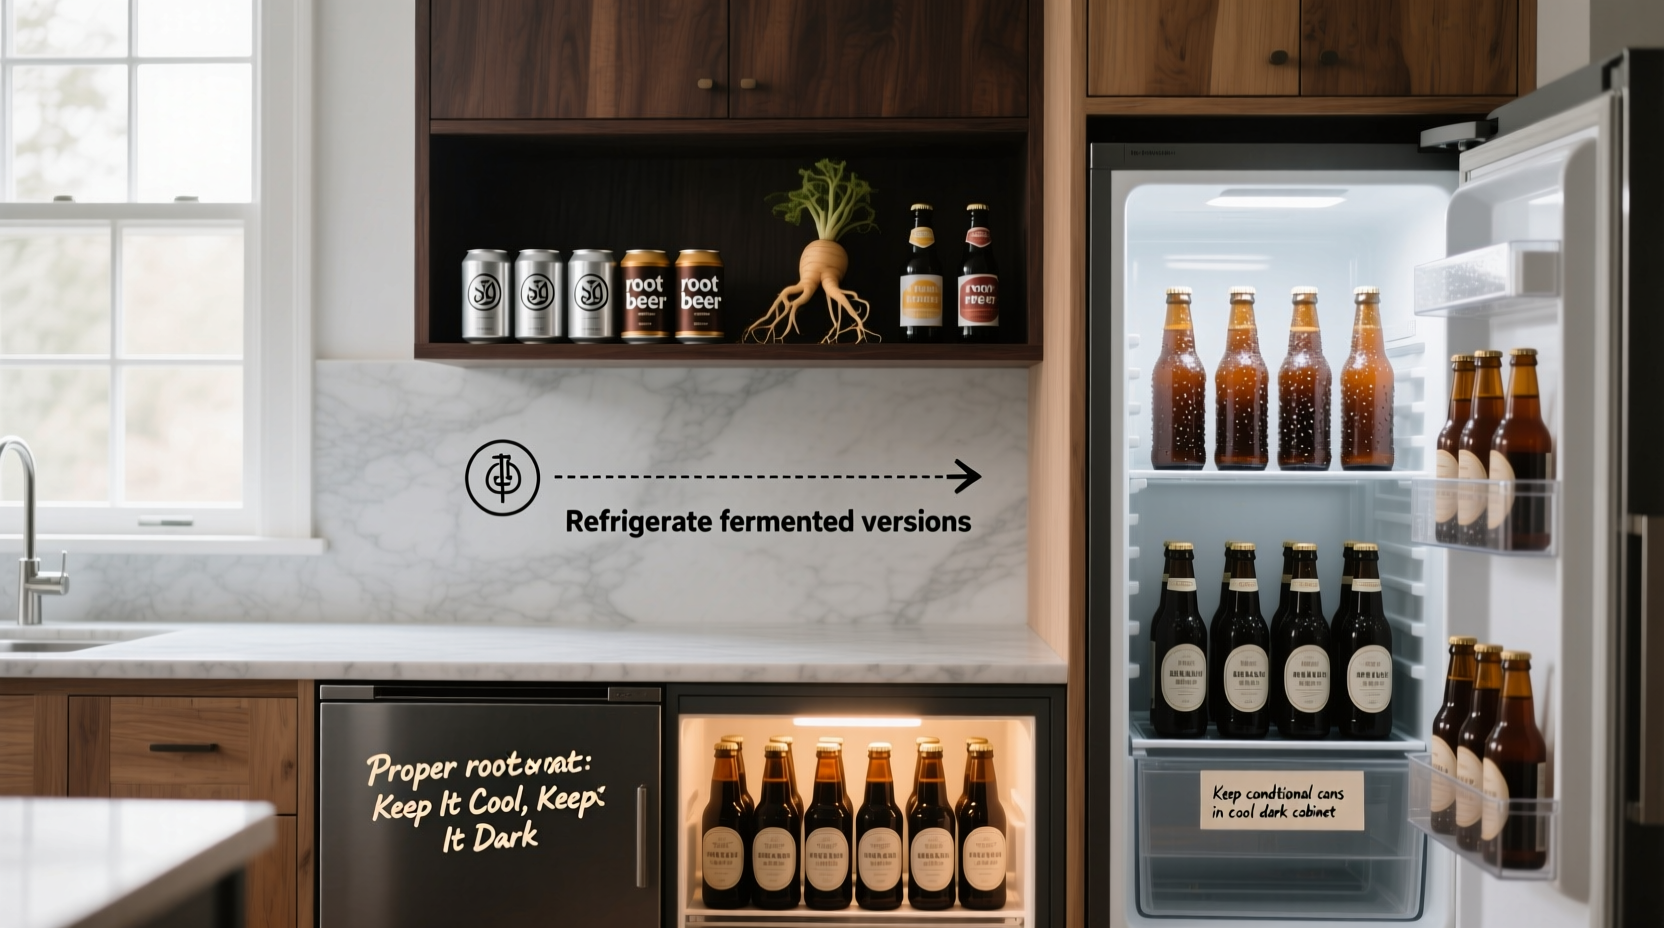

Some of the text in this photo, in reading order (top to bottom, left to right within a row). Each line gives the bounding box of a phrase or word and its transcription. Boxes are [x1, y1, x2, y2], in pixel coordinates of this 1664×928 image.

[626, 275, 664, 292] root
[681, 275, 719, 292] root
[626, 293, 667, 310] beer
[681, 293, 722, 310] beer
[565, 508, 972, 539] Refrigerate fermented versions
[366, 753, 457, 792] Proper
[1213, 783, 1345, 805] Keep condtional cans
[372, 793, 432, 828] Keep
[439, 789, 462, 817] It
[469, 784, 528, 817] Cool,
[1212, 805, 1224, 819] in
[1228, 803, 1256, 819] cool
[1259, 804, 1288, 819] dark
[443, 819, 539, 853] It Dark
